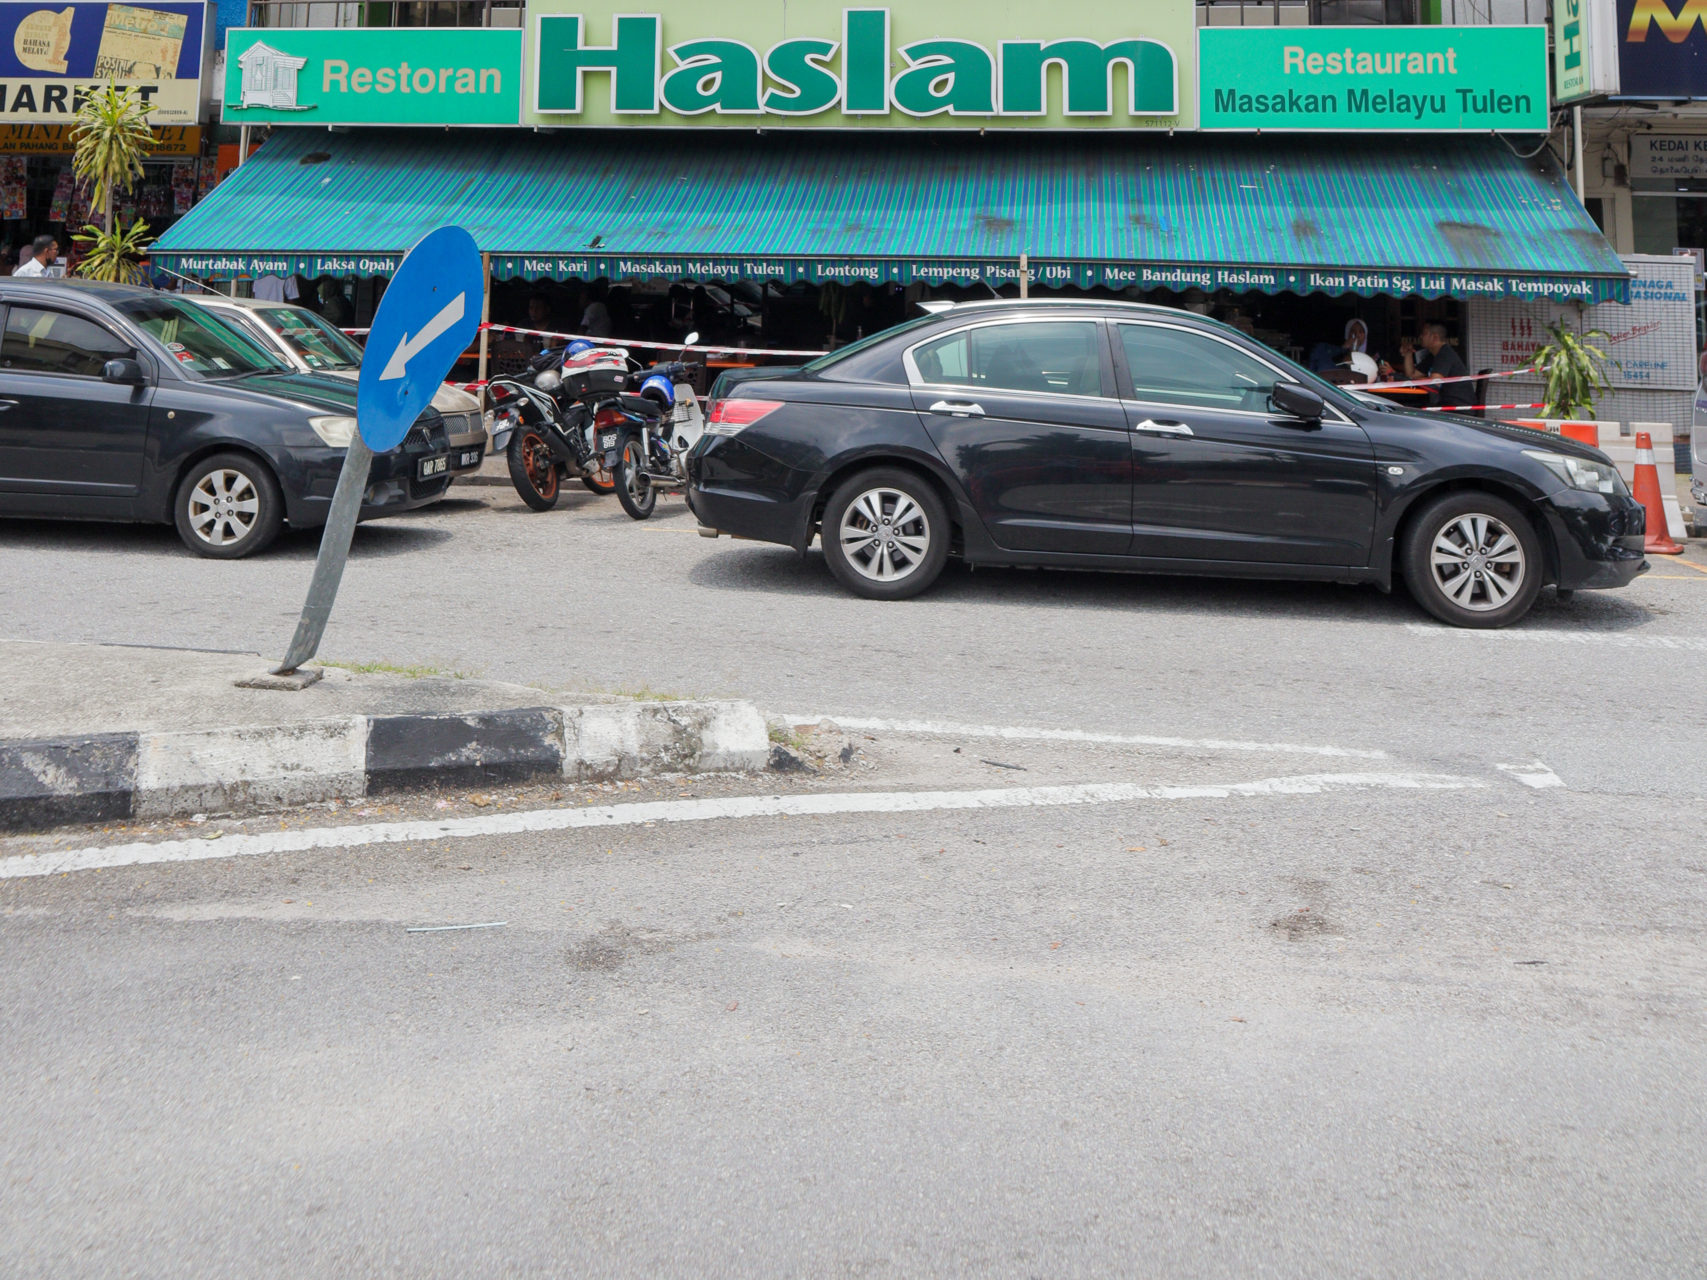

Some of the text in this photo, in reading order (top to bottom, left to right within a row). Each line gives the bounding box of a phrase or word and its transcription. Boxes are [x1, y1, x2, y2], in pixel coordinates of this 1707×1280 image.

[534, 7, 1179, 116] Haslam
[1283, 46, 1458, 75] Restaurant
[322, 59, 502, 94] Restoran
[1214, 87, 1531, 120] Masakan Melayu Tulen
[1650, 140, 1689, 151] KEDAI
[180, 258, 288, 272] Murtabak Ayam
[316, 258, 395, 273] Laksa Opah
[523, 259, 588, 272] Mee Kari
[618, 260, 785, 276] Masakan Melayu Tulen
[817, 264, 879, 280] Lontong
[911, 264, 980, 281] Lempeng
[1045, 266, 1072, 279] Ubi
[1104, 267, 1275, 285] Mee Bandung Haslam
[1310, 273, 1592, 296] Ikan Patin Sg. Lui Masak Tempoyak
[1631, 280, 1673, 289] ENAGA
